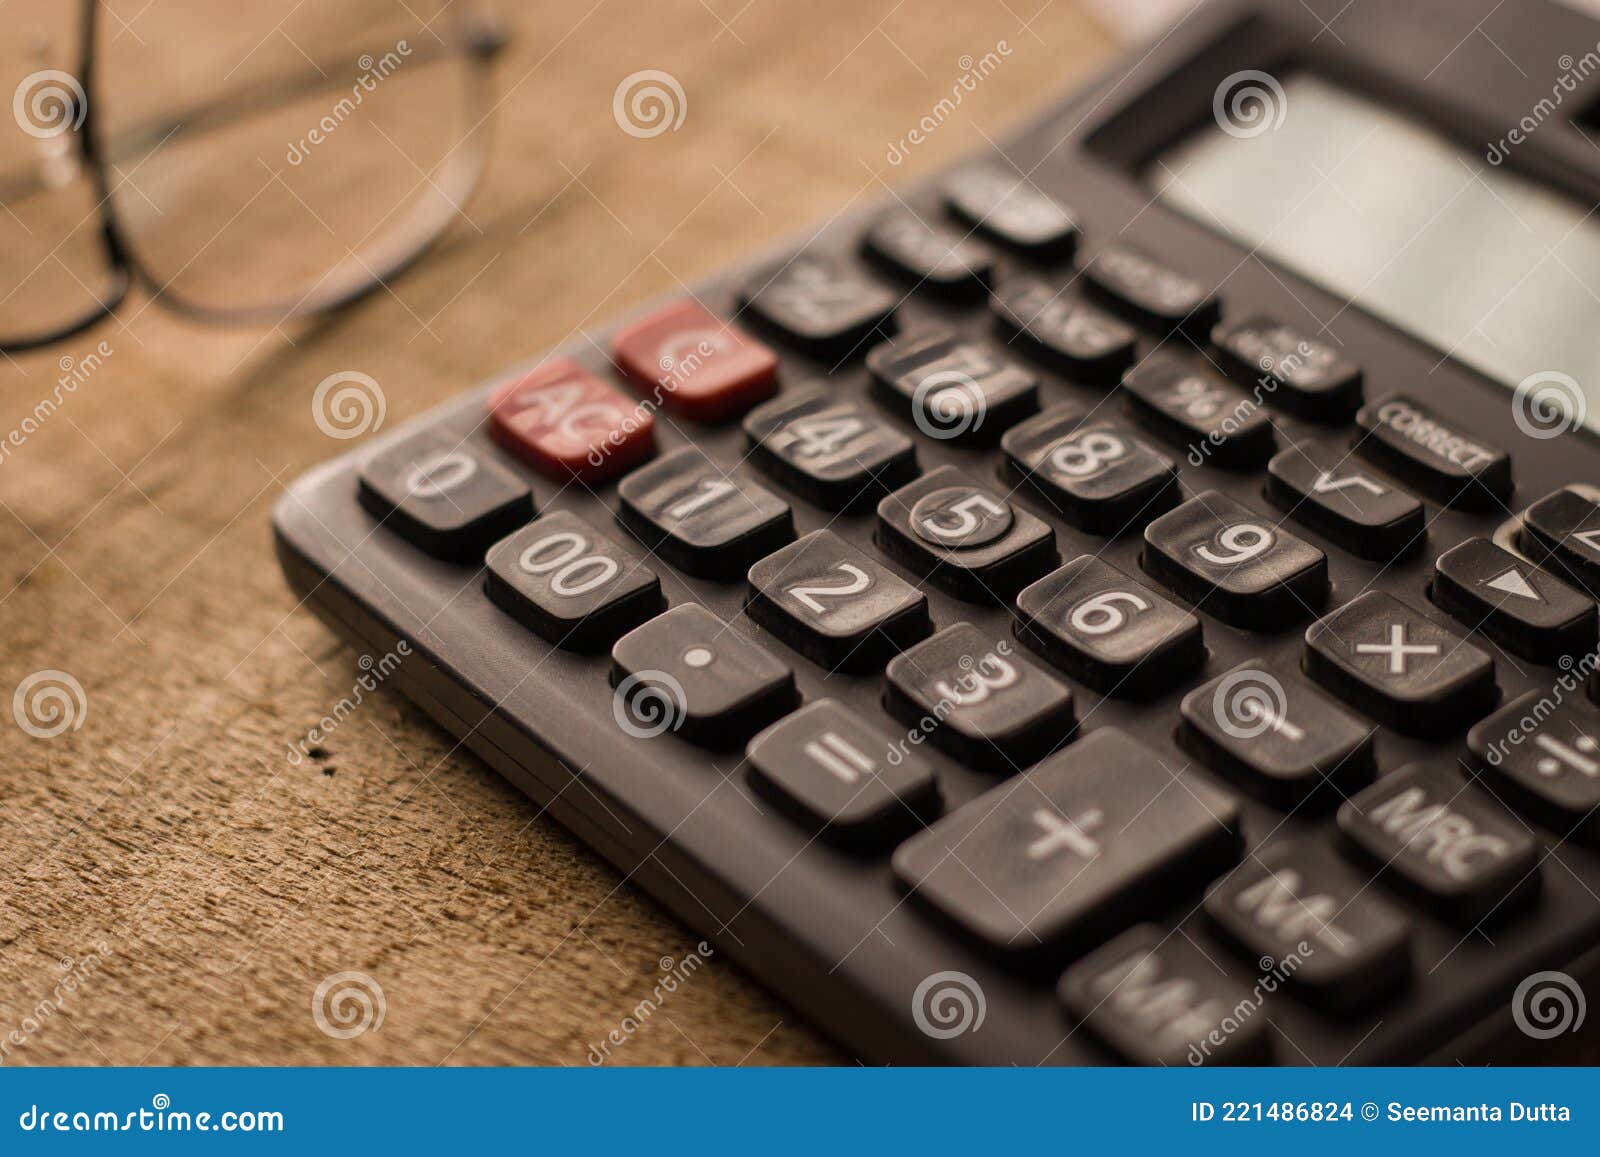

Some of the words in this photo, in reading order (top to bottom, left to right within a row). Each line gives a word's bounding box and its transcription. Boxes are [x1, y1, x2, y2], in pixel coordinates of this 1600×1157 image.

[522, 385, 624, 440] AC
[795, 417, 862, 456] 4
[1052, 433, 1125, 475] 8
[1377, 402, 1495, 469] CORRECT
[407, 453, 478, 497] 0
[670, 479, 735, 518] 1
[923, 495, 1003, 538] 5
[519, 532, 618, 595] 00
[1196, 523, 1272, 564] 9
[788, 563, 870, 614] 2
[1071, 592, 1148, 634] 6
[936, 654, 1020, 706] 3
[1371, 786, 1508, 879] MRC
